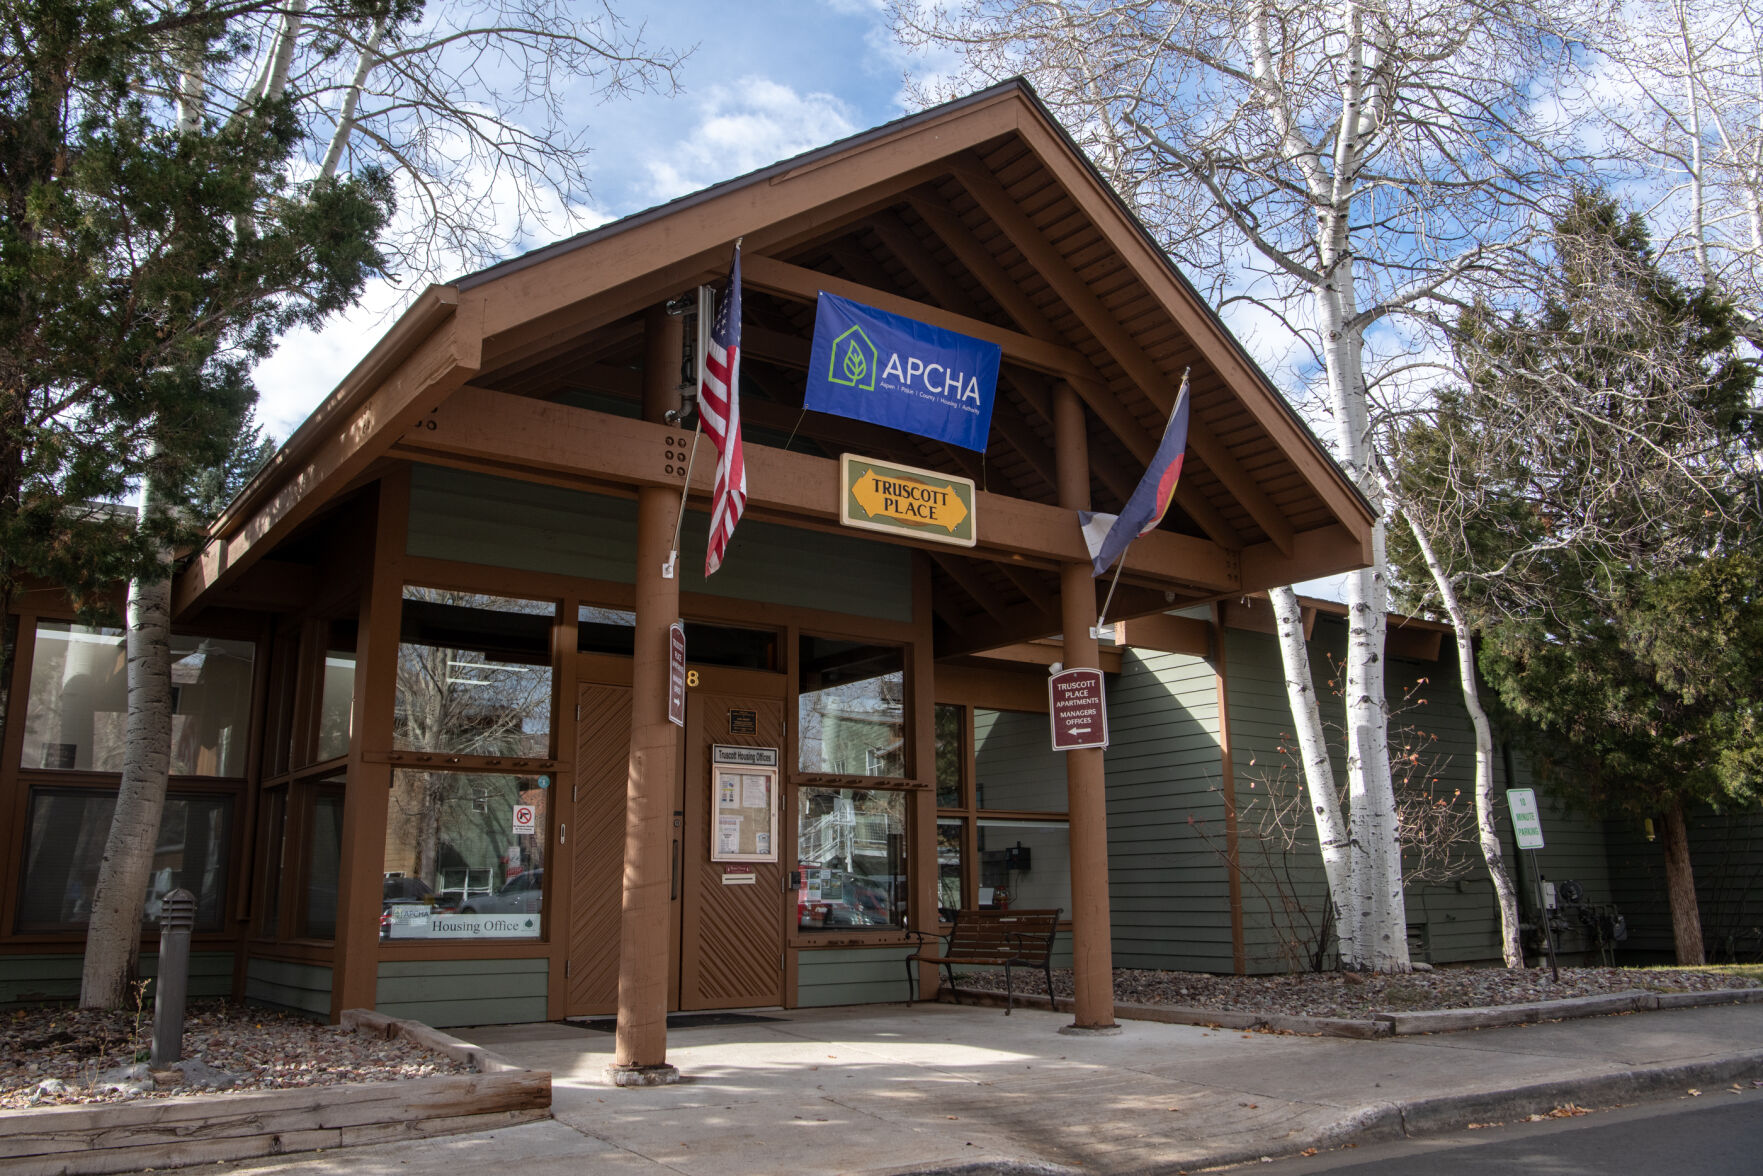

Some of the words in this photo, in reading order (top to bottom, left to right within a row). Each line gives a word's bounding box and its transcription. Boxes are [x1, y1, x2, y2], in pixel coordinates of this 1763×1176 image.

[882, 353, 980, 405] APCHA
[872, 478, 948, 505] TRUSCOTT
[884, 497, 938, 520] PLACE
[1058, 680, 1095, 691] TRUSCOTT
[1065, 690, 1088, 698] PLACE
[1056, 697, 1099, 708] APARTMENTS
[1060, 709, 1096, 718] MANAGERS
[719, 750, 737, 760] Truscott
[737, 751, 756, 763] Housing
[756, 752, 772, 762] Offices
[432, 920, 481, 934] Housing
[484, 920, 519, 932] Office
